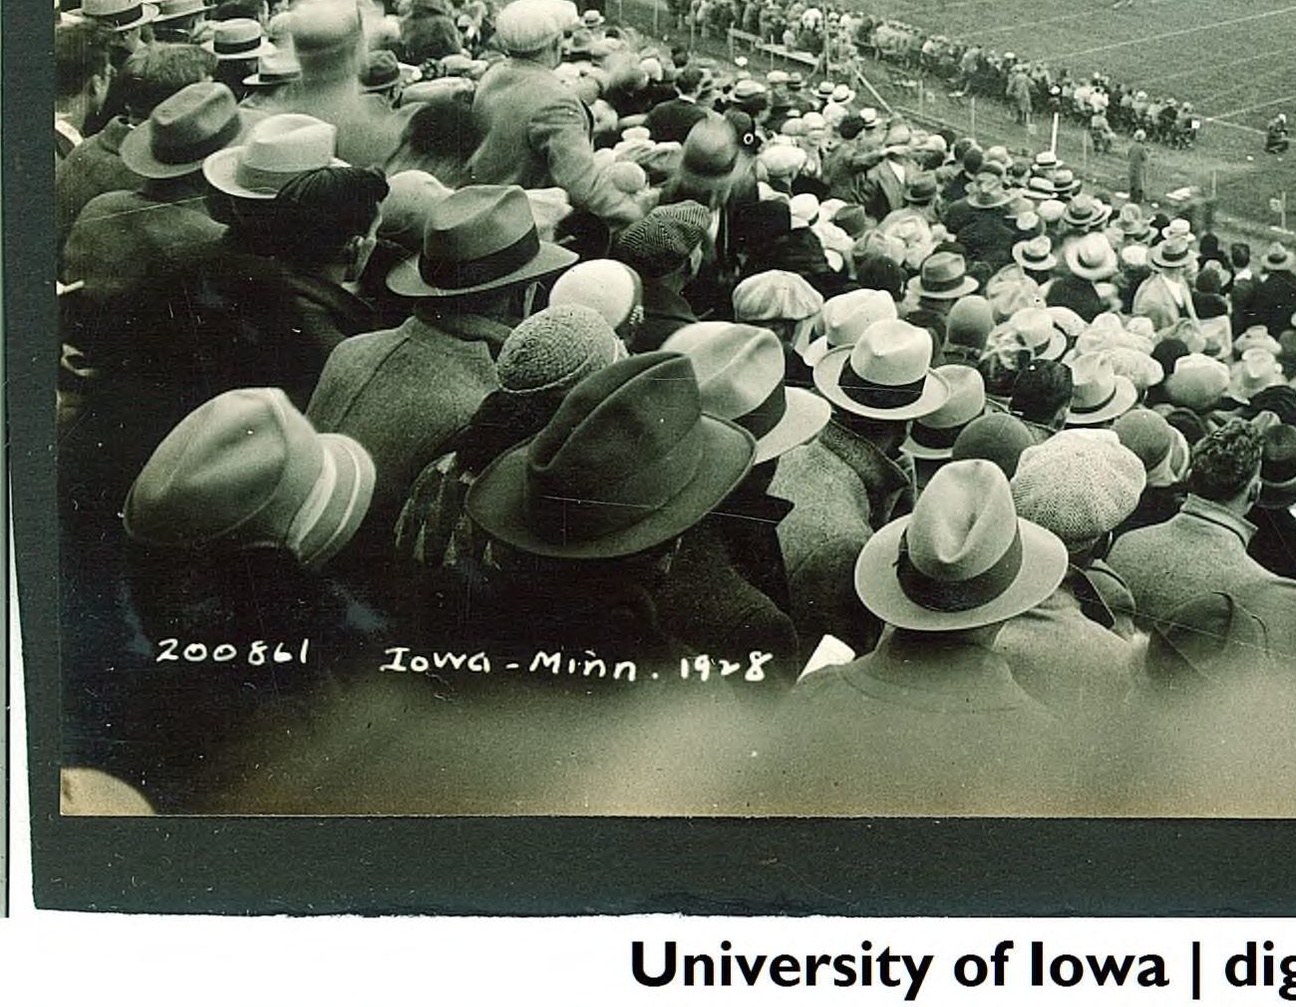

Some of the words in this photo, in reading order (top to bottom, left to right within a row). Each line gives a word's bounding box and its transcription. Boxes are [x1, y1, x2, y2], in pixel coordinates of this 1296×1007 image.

[155, 637, 310, 666] 200861
[379, 647, 491, 672] Iowa
[680, 651, 774, 682] 1928
